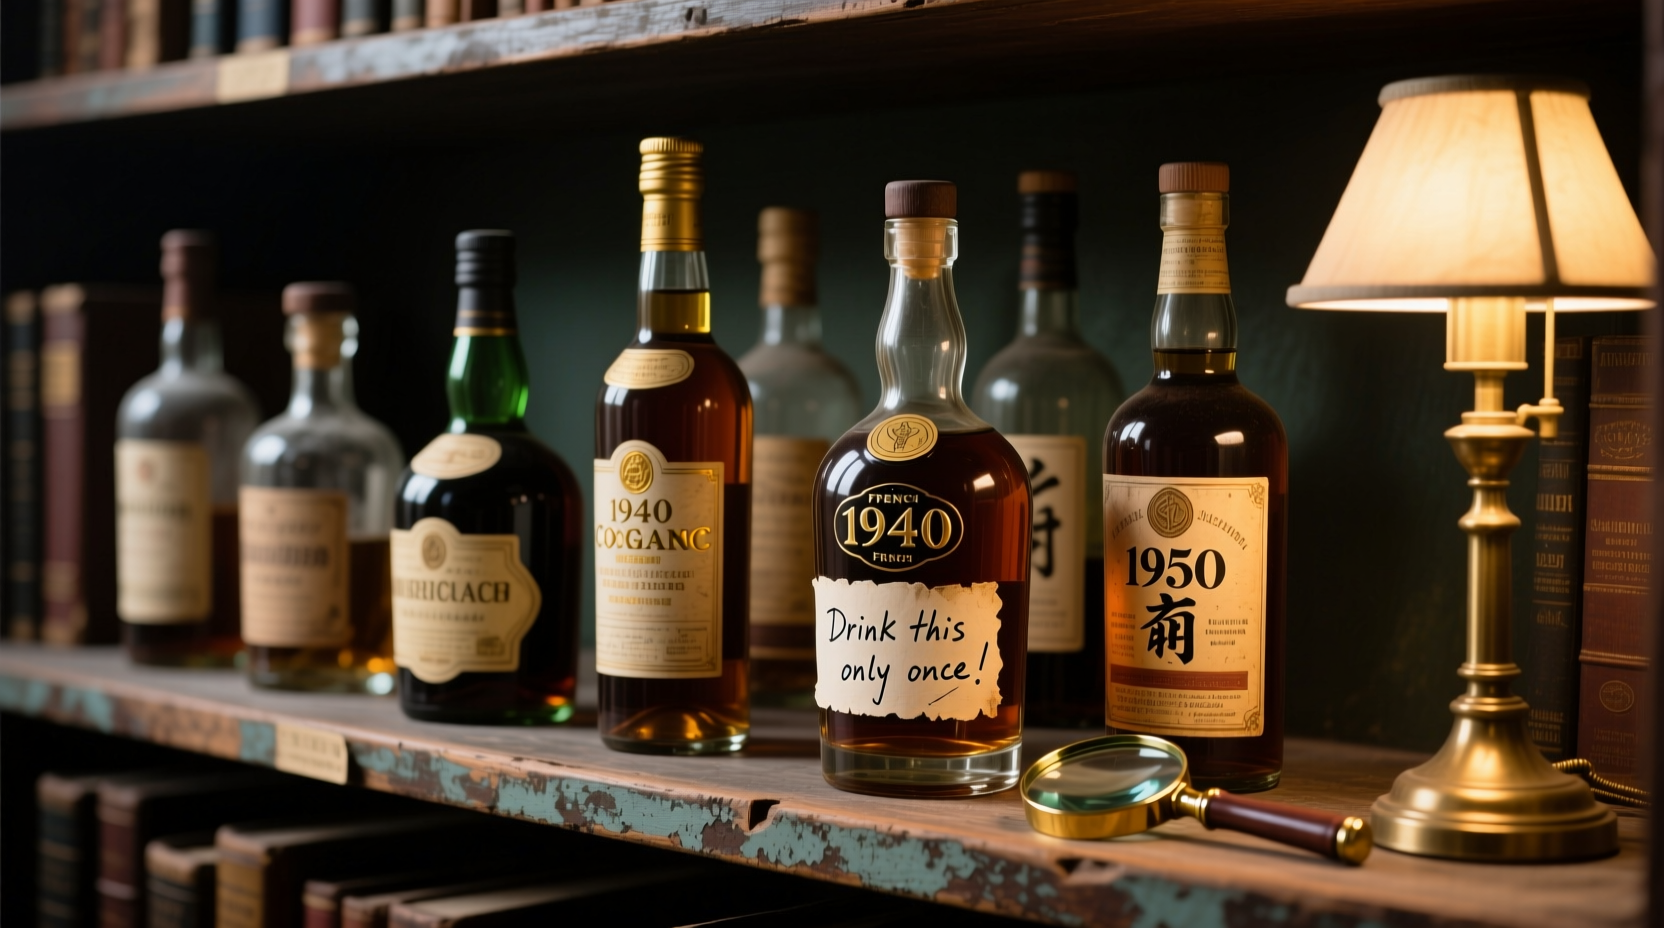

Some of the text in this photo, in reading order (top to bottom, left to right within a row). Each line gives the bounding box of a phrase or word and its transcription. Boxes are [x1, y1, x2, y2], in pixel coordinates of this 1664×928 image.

[610, 498, 673, 524] 1940
[841, 505, 953, 550] 1940
[1125, 545, 1227, 590] 1950
[826, 607, 966, 643] Drink this
[840, 641, 989, 706] only once!
